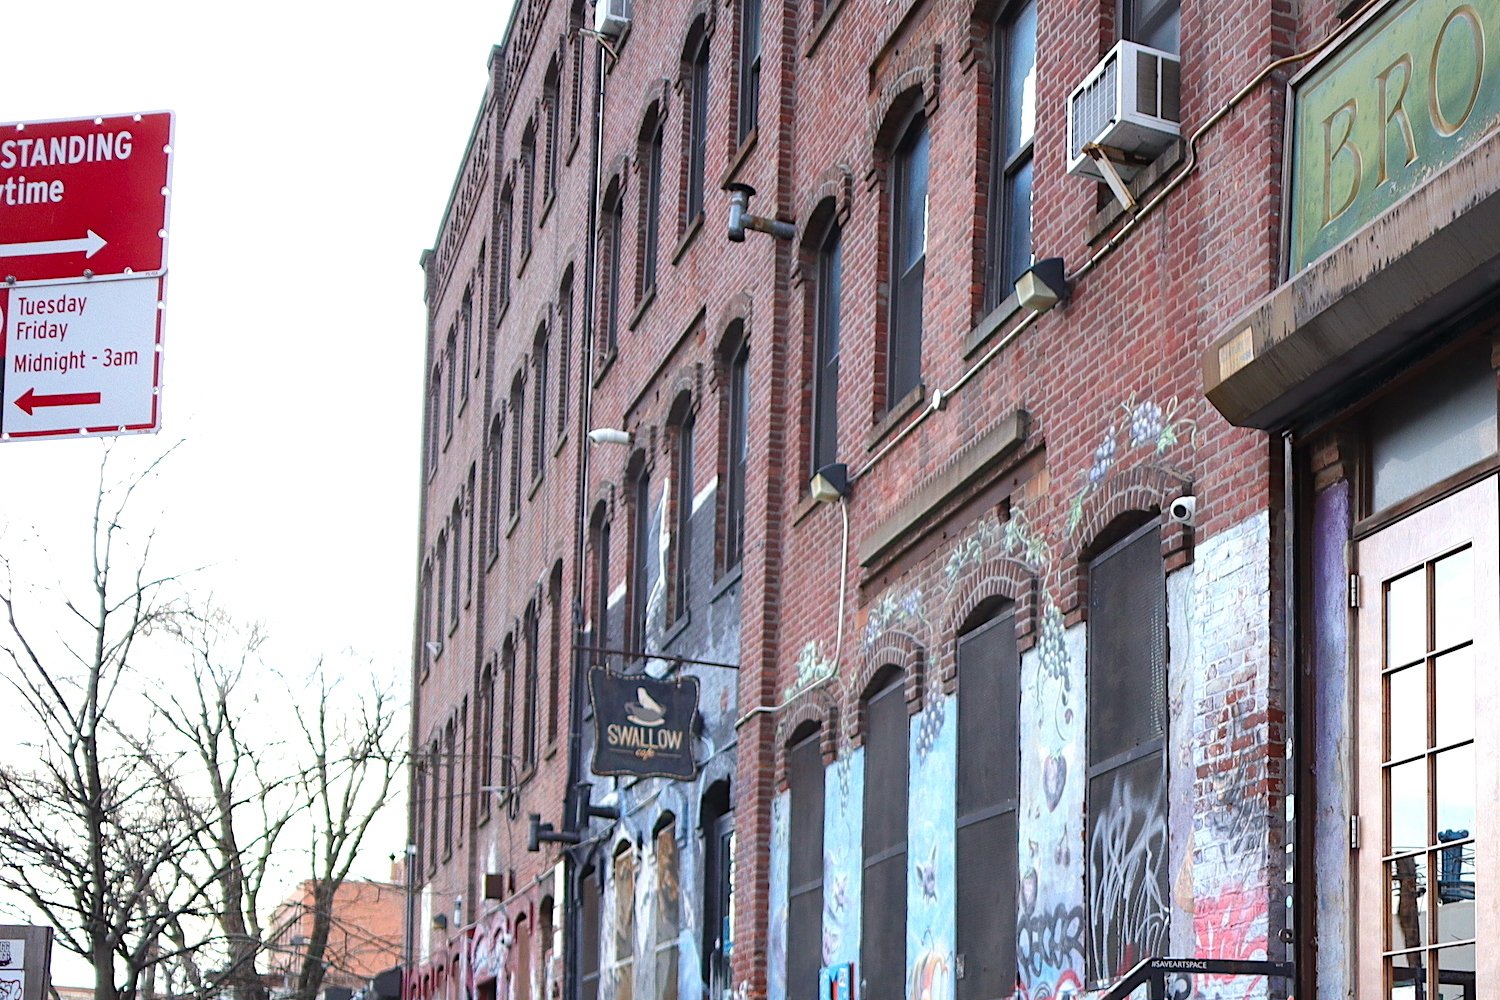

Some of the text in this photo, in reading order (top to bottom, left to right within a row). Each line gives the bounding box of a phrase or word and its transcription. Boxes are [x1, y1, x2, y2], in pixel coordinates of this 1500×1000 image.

[1, 131, 132, 170] STANDING
[18, 295, 87, 316] Tuesday
[16, 321, 68, 341] Friday
[14, 350, 86, 375] Midnight
[103, 348, 138, 367] 3am
[607, 723, 683, 749] SWALLOW
[1151, 960, 1208, 969] #SAVEARTSPACE
